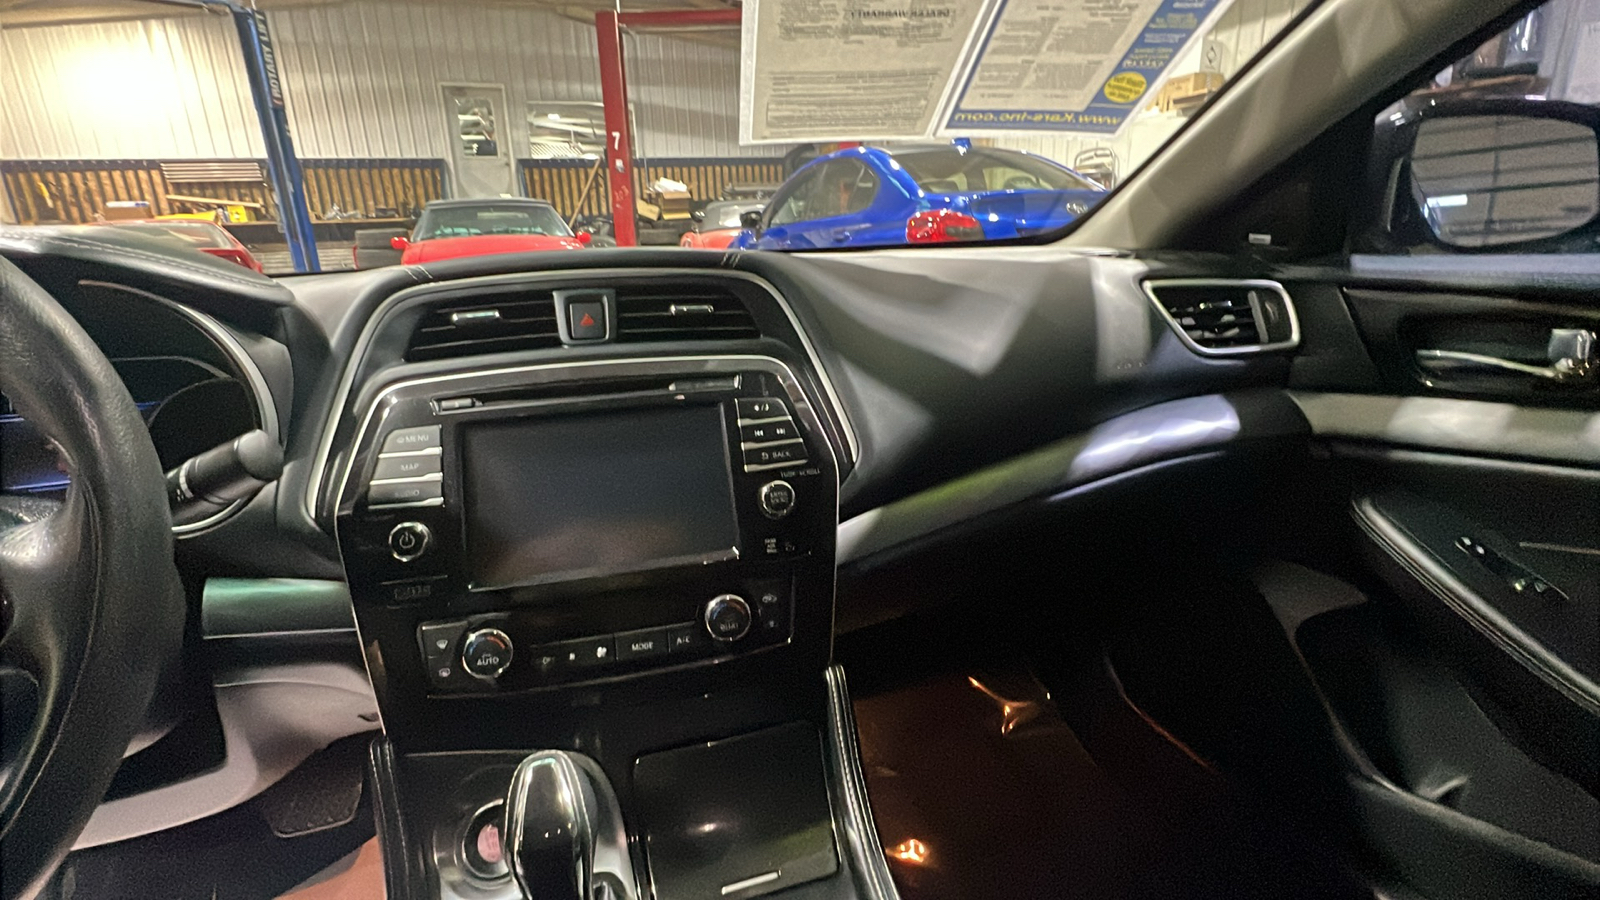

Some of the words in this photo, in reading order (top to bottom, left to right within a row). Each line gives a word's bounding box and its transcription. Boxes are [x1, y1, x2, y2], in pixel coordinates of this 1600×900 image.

[254, 10, 270, 42] LIFT
[262, 43, 282, 101] ROTARY
[611, 131, 621, 151] 7
[405, 434, 429, 444] MENU
[772, 451, 791, 460] BACK
[400, 463, 419, 471] MAP
[631, 641, 654, 651] MODE
[476, 656, 500, 666] AUTO
